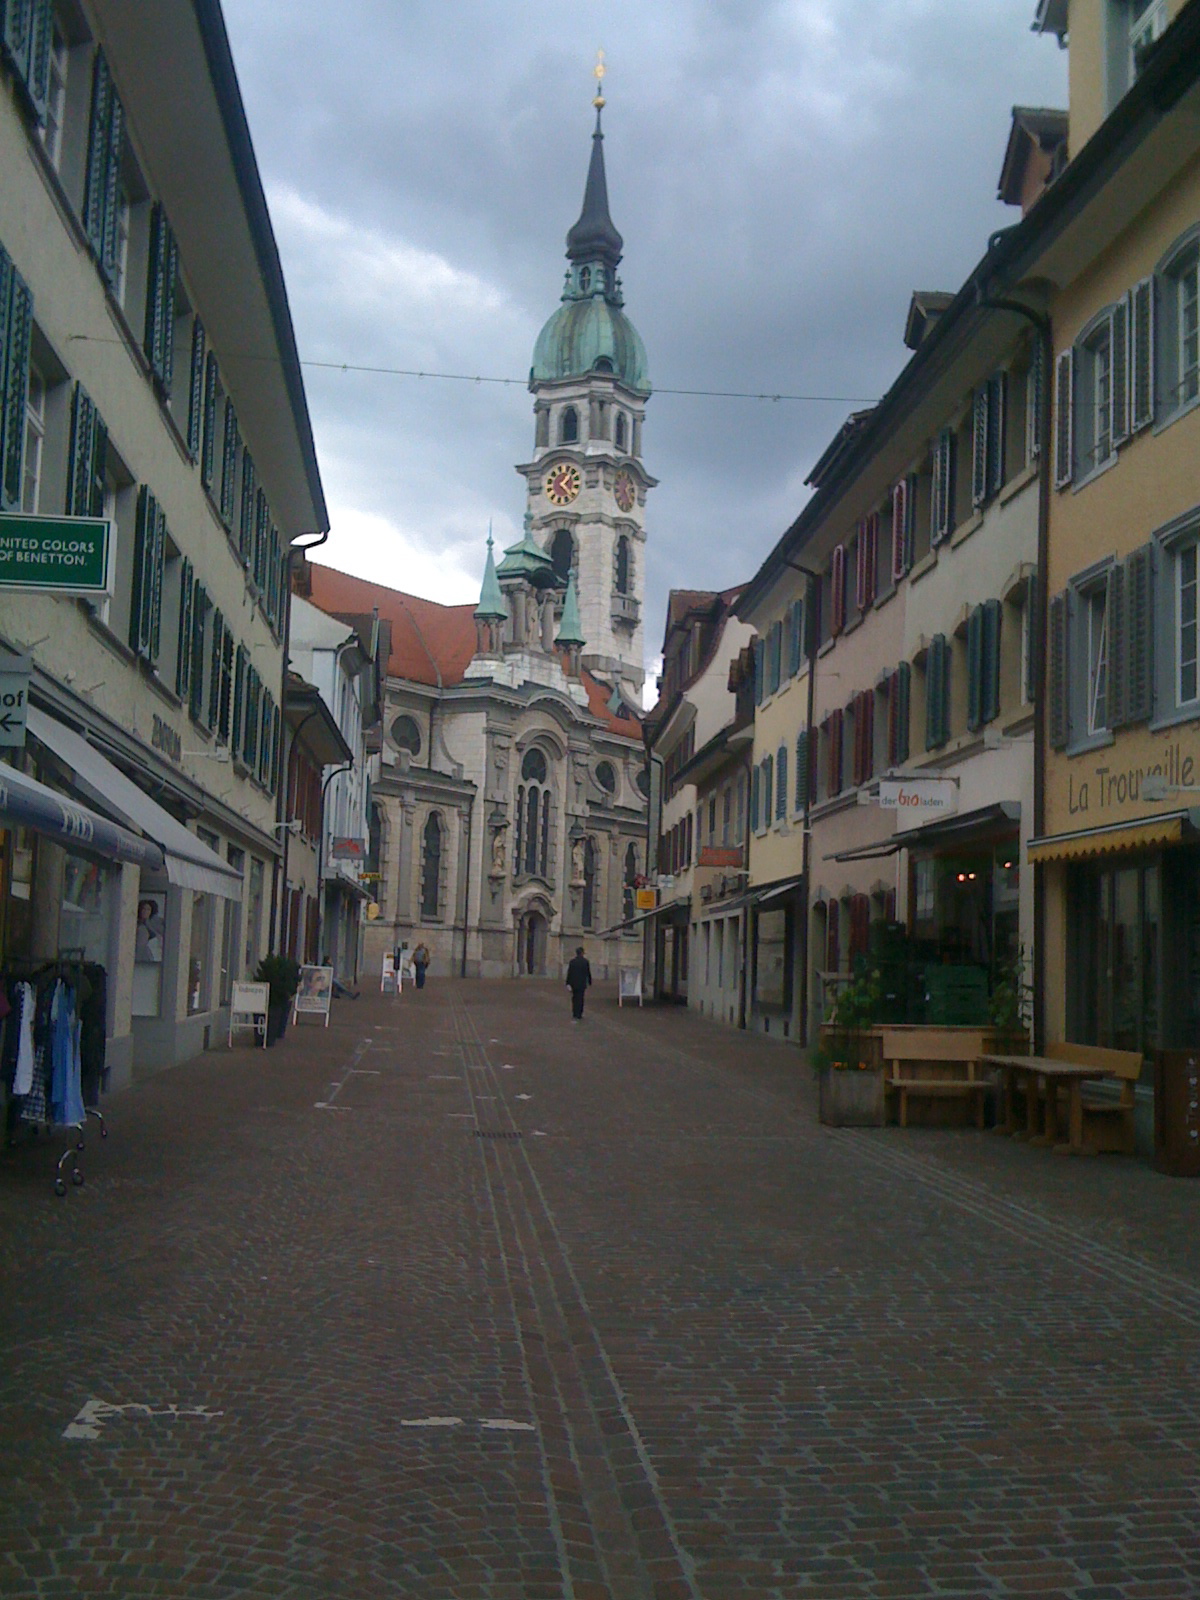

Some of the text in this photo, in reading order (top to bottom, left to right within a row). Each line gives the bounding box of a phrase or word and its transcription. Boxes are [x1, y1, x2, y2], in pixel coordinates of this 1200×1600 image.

[0, 537, 95, 553] NITED COLORS
[0, 690, 24, 707] of
[881, 787, 944, 807] der bio laden
[1069, 773, 1089, 815] La
